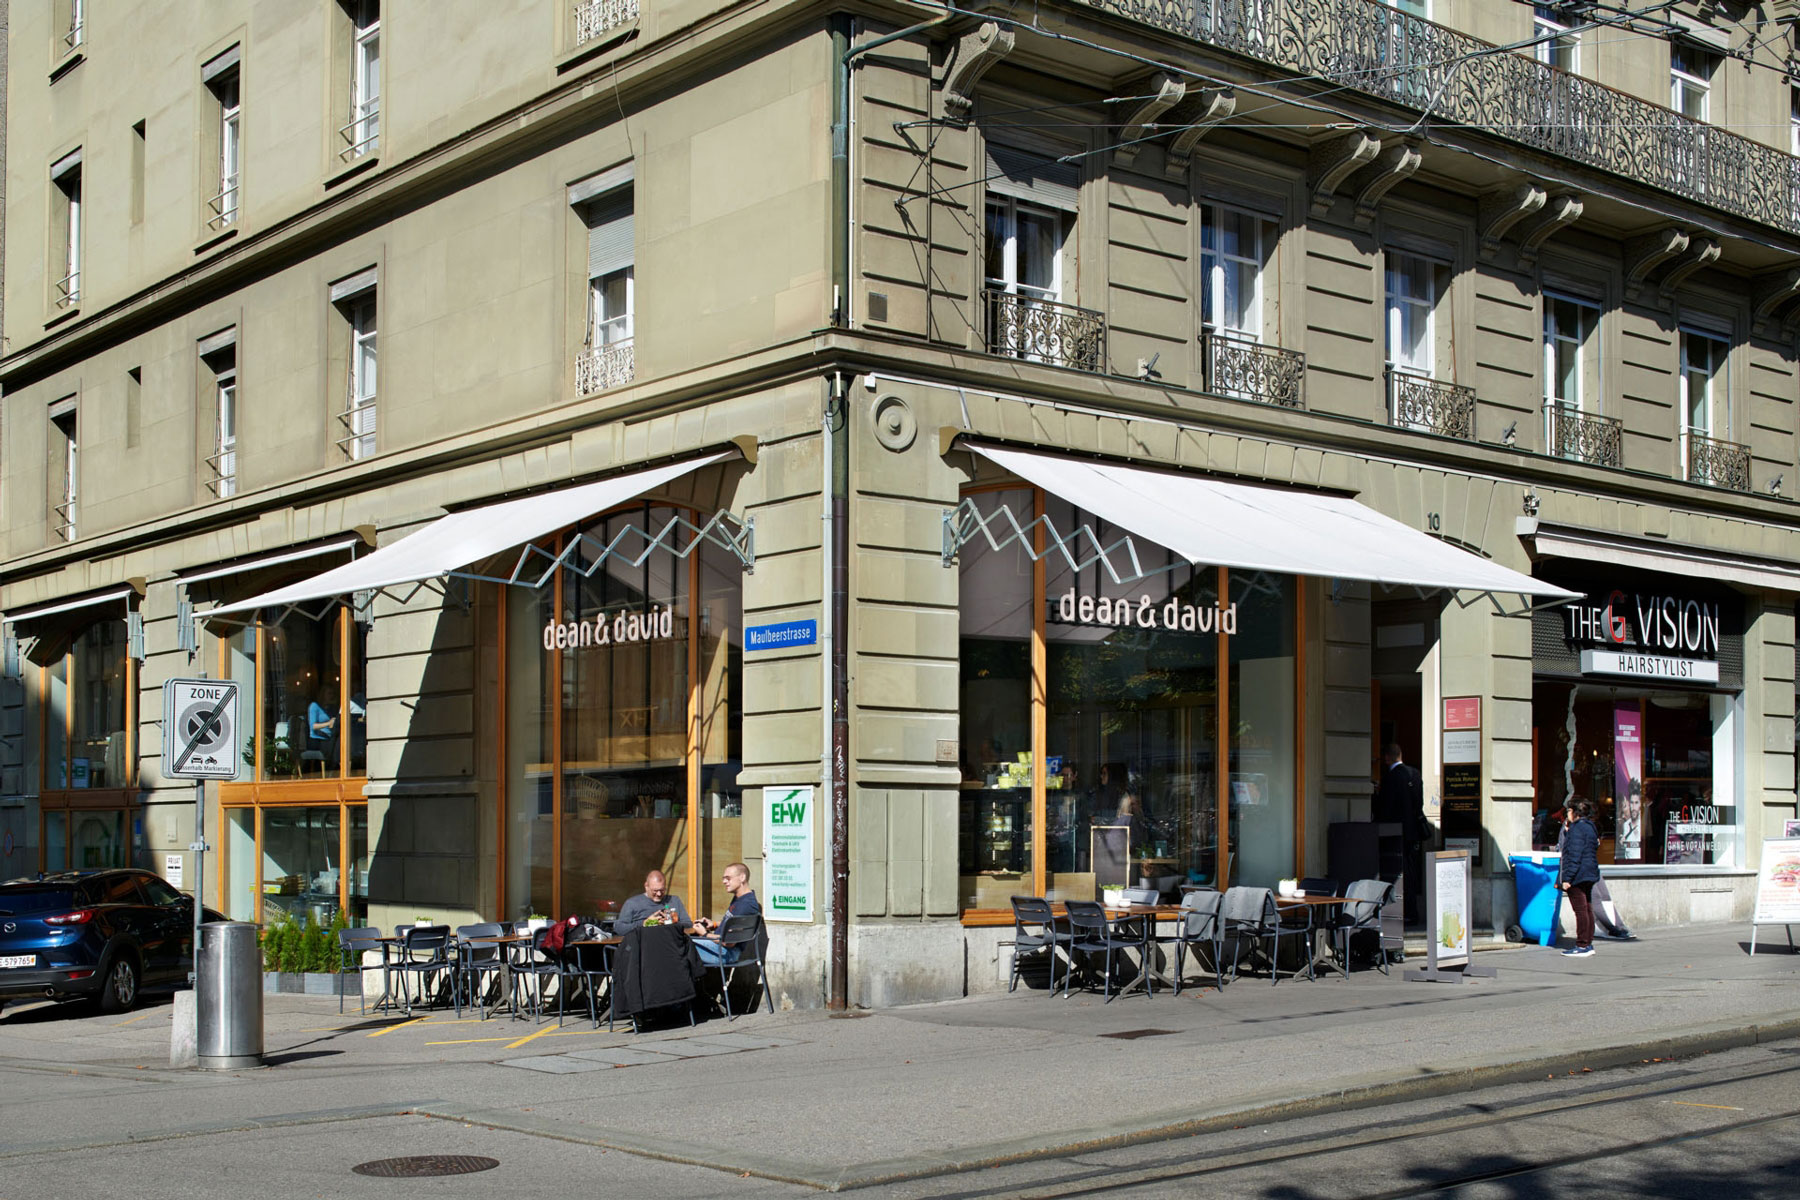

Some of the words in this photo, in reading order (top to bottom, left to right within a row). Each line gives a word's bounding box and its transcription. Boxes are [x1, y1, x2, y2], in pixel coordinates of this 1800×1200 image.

[1427, 512, 1440, 531] 10
[1564, 604, 1602, 640] THE
[1602, 590, 1626, 643] G
[1636, 594, 1718, 652] VISION
[750, 627, 811, 645] Maulbeerstrasse
[1619, 655, 1694, 677] HAIRSTYLIST
[191, 688, 221, 700] ZONE
[1669, 811, 1680, 823] THE
[1682, 805, 1689, 824] G
[1690, 805, 1719, 824] VISION
[1668, 841, 1684, 851] OHNE
[778, 896, 806, 904] EINGANG
